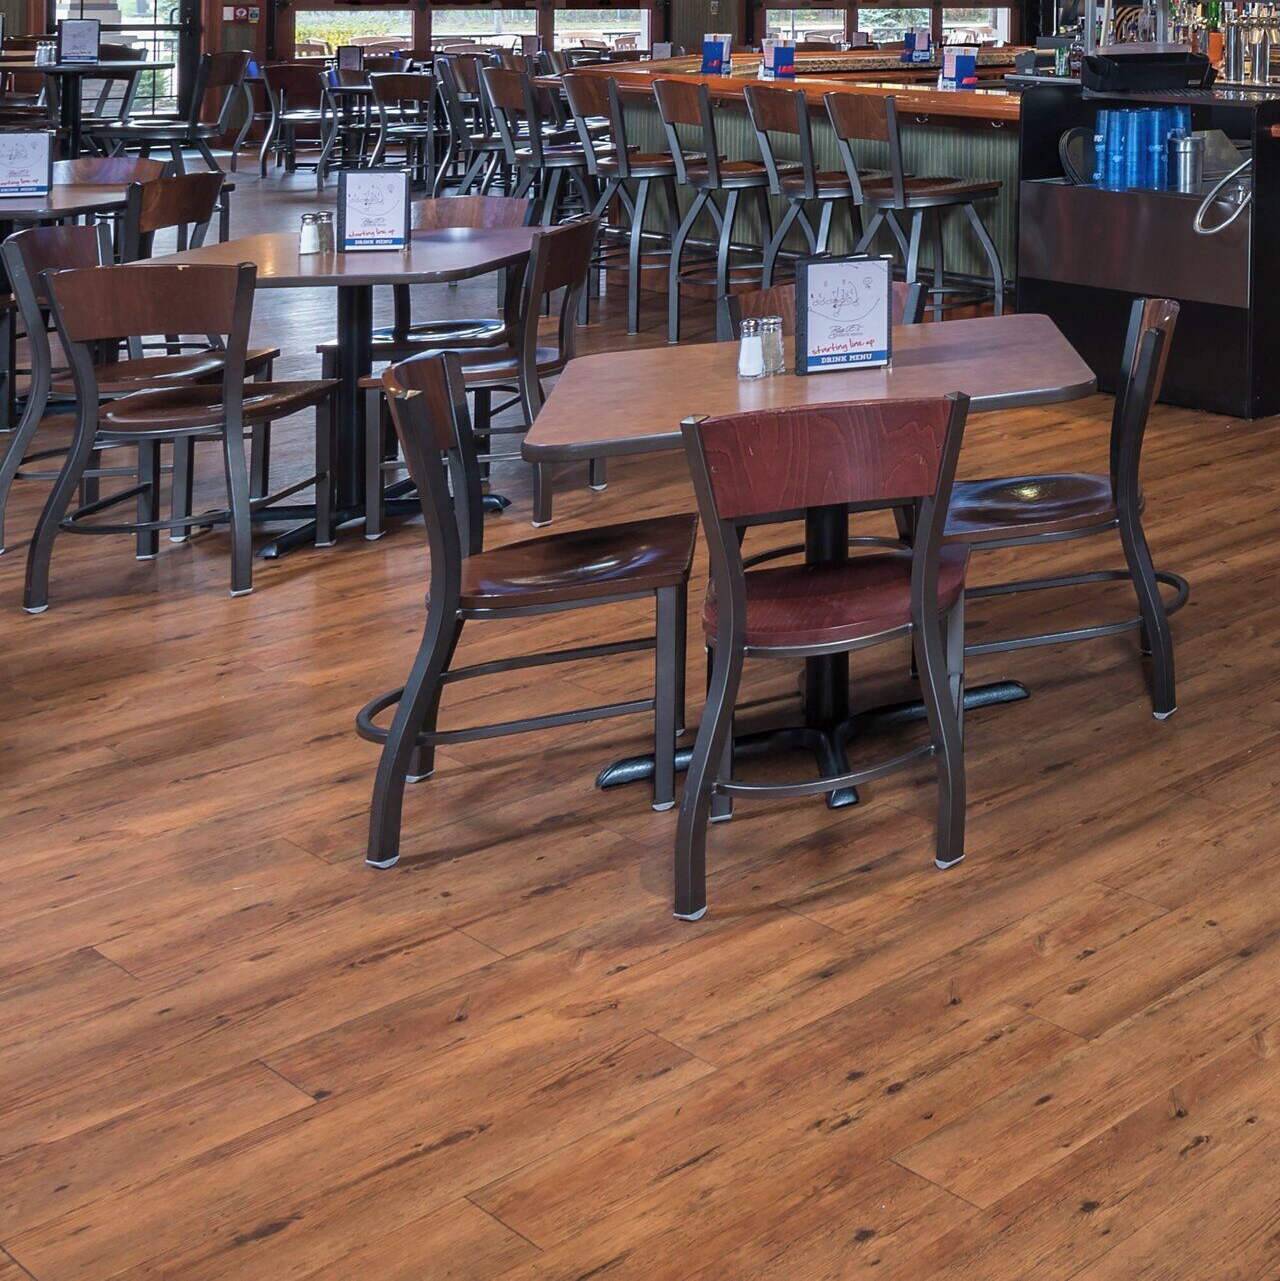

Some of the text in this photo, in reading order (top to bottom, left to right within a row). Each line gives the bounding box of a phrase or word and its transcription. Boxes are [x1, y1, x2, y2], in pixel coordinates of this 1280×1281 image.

[812, 338, 875, 355] starting line up
[821, 356, 847, 364] DRINK
